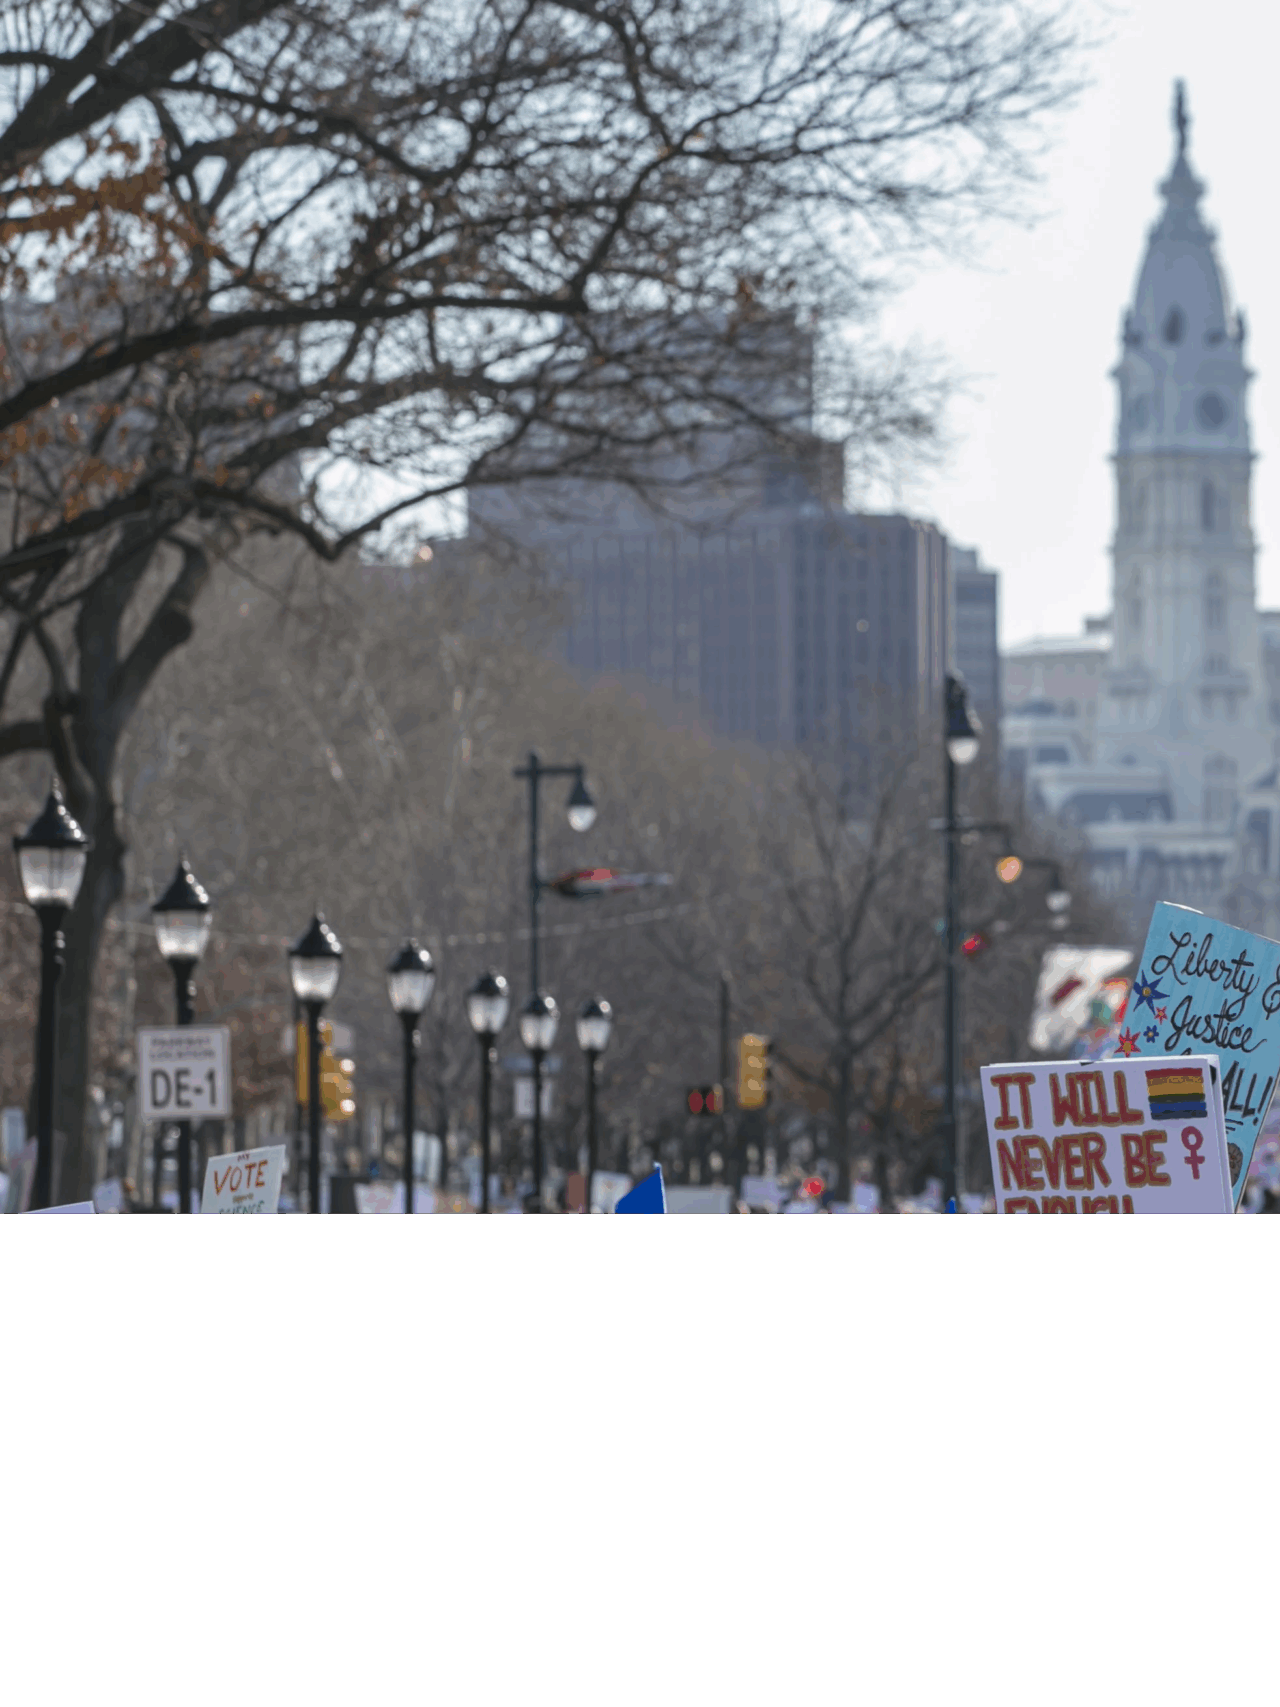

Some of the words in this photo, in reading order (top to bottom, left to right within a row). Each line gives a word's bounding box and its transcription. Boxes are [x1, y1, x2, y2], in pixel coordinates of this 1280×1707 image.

[1151, 931, 1259, 1021] Liberty
[1164, 996, 1267, 1053] Justice
[151, 1068, 218, 1109] DE-1
[990, 1072, 1036, 1130] IT
[1049, 1070, 1144, 1128] WILL
[213, 1159, 269, 1195] VOTE
[996, 1131, 1112, 1191] NEVER
[1121, 1130, 1171, 1188] BE
